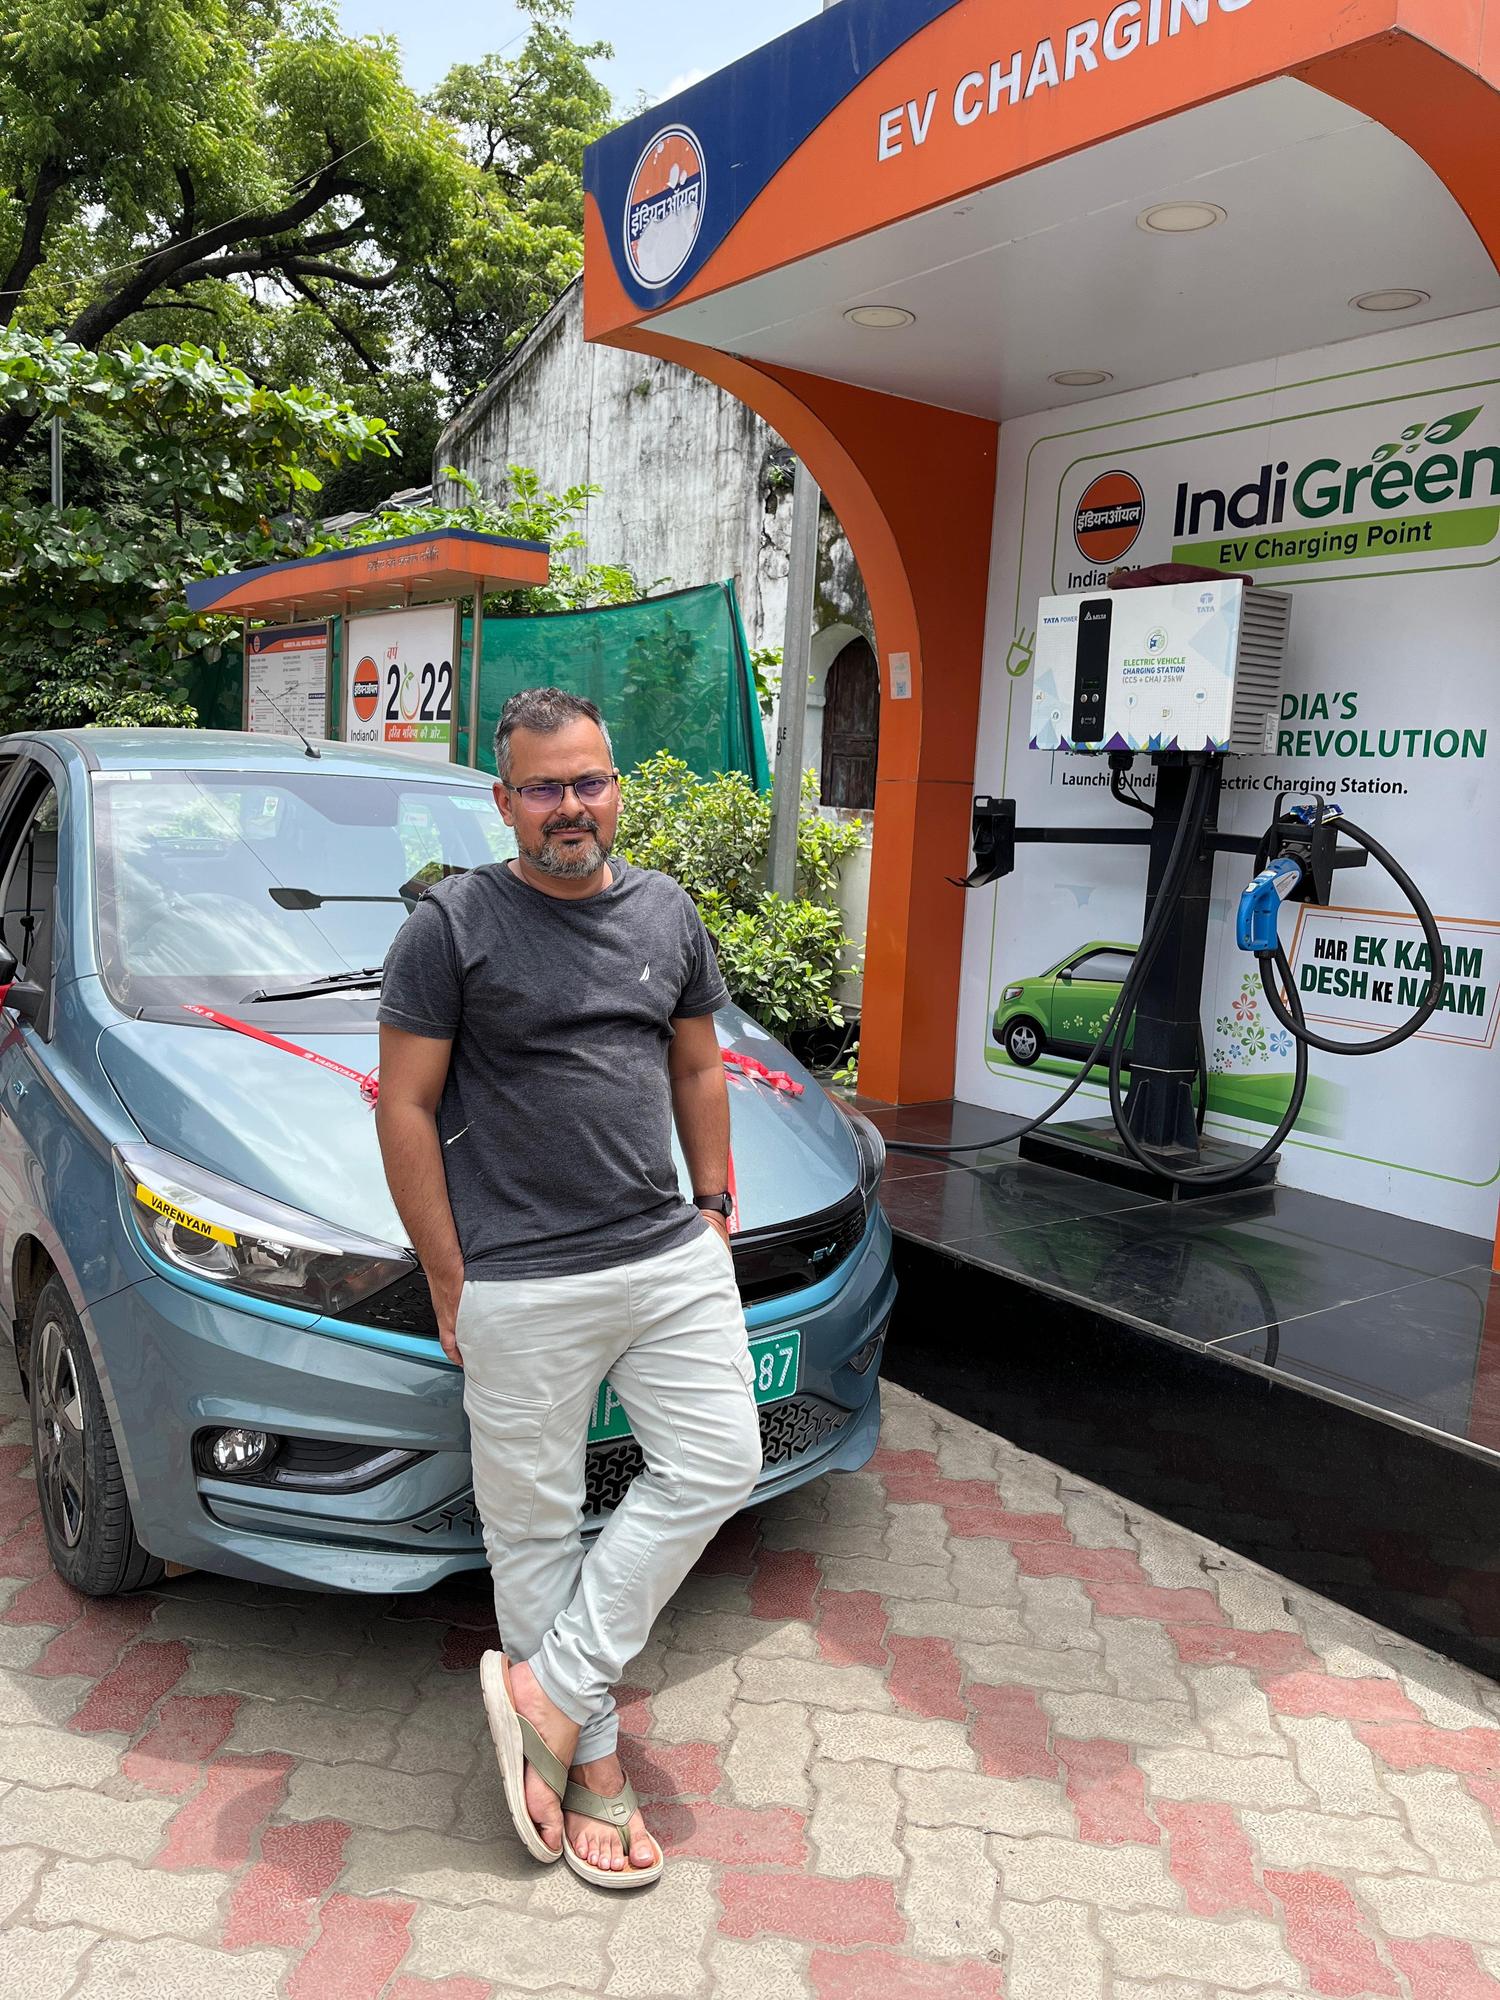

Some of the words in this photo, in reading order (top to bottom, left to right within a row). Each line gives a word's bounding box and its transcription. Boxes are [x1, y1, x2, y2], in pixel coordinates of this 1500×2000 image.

[877, 88, 939, 162] EV
[952, 0, 1254, 126] CHARGIN
[1173, 446, 1500, 537] IndiGreen
[1077, 506, 1141, 532] इंडियनऑयल
[1219, 541, 1248, 563] EV
[1255, 531, 1359, 560] Charging
[1367, 521, 1432, 548] Point
[1122, 667, 1156, 675] CHARGING
[1156, 666, 1186, 674] STATION
[1123, 658, 1155, 666] ELECTRIC
[1156, 657, 1187, 665] VEHICLE
[386, 661, 452, 721] 2022
[1122, 676, 1138, 684] (CCS
[1144, 675, 1161, 684] CHA)
[1163, 675, 1184, 683] 25kW
[350, 729, 379, 742] IndianOil
[1277, 729, 1488, 758] REVOLUTION
[1062, 772, 1126, 790] Launchig
[1130, 773, 1157, 788] Indi
[1263, 776, 1336, 796] Charging
[1341, 777, 1408, 794] Station.
[1314, 937, 1348, 962] HAR
[1353, 935, 1389, 967] EK
[1300, 964, 1369, 1000] DESH
[1372, 980, 1394, 1003] KE
[151, 1195, 212, 1236] VARENYAM
